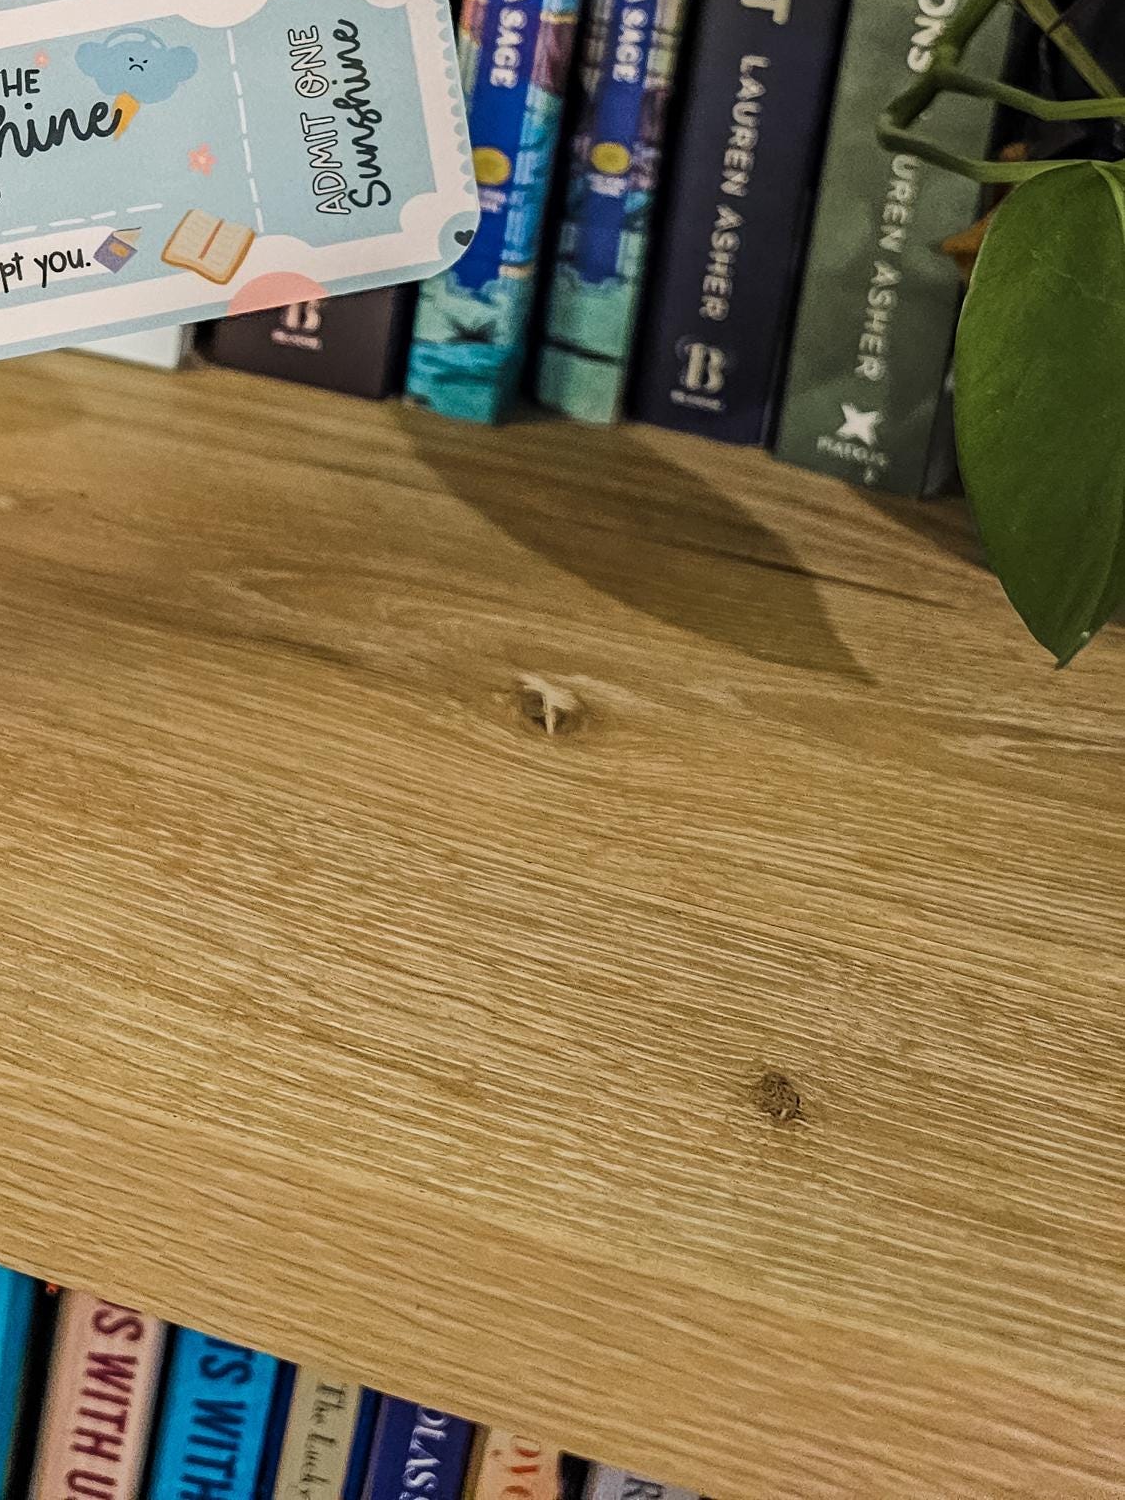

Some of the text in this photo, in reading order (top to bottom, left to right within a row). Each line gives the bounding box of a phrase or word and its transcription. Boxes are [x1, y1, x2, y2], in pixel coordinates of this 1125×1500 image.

[488, 6, 528, 89] SAGE
[612, 4, 649, 85] SAGE
[287, 23, 352, 216] ADMIT ONE
[330, 17, 393, 208] Sunshine
[720, 54, 771, 198] LAUREN
[33, 243, 94, 288] you.
[698, 204, 745, 322] ASHER
[854, 260, 902, 382] ASHER
[69, 1351, 139, 1462] WITH
